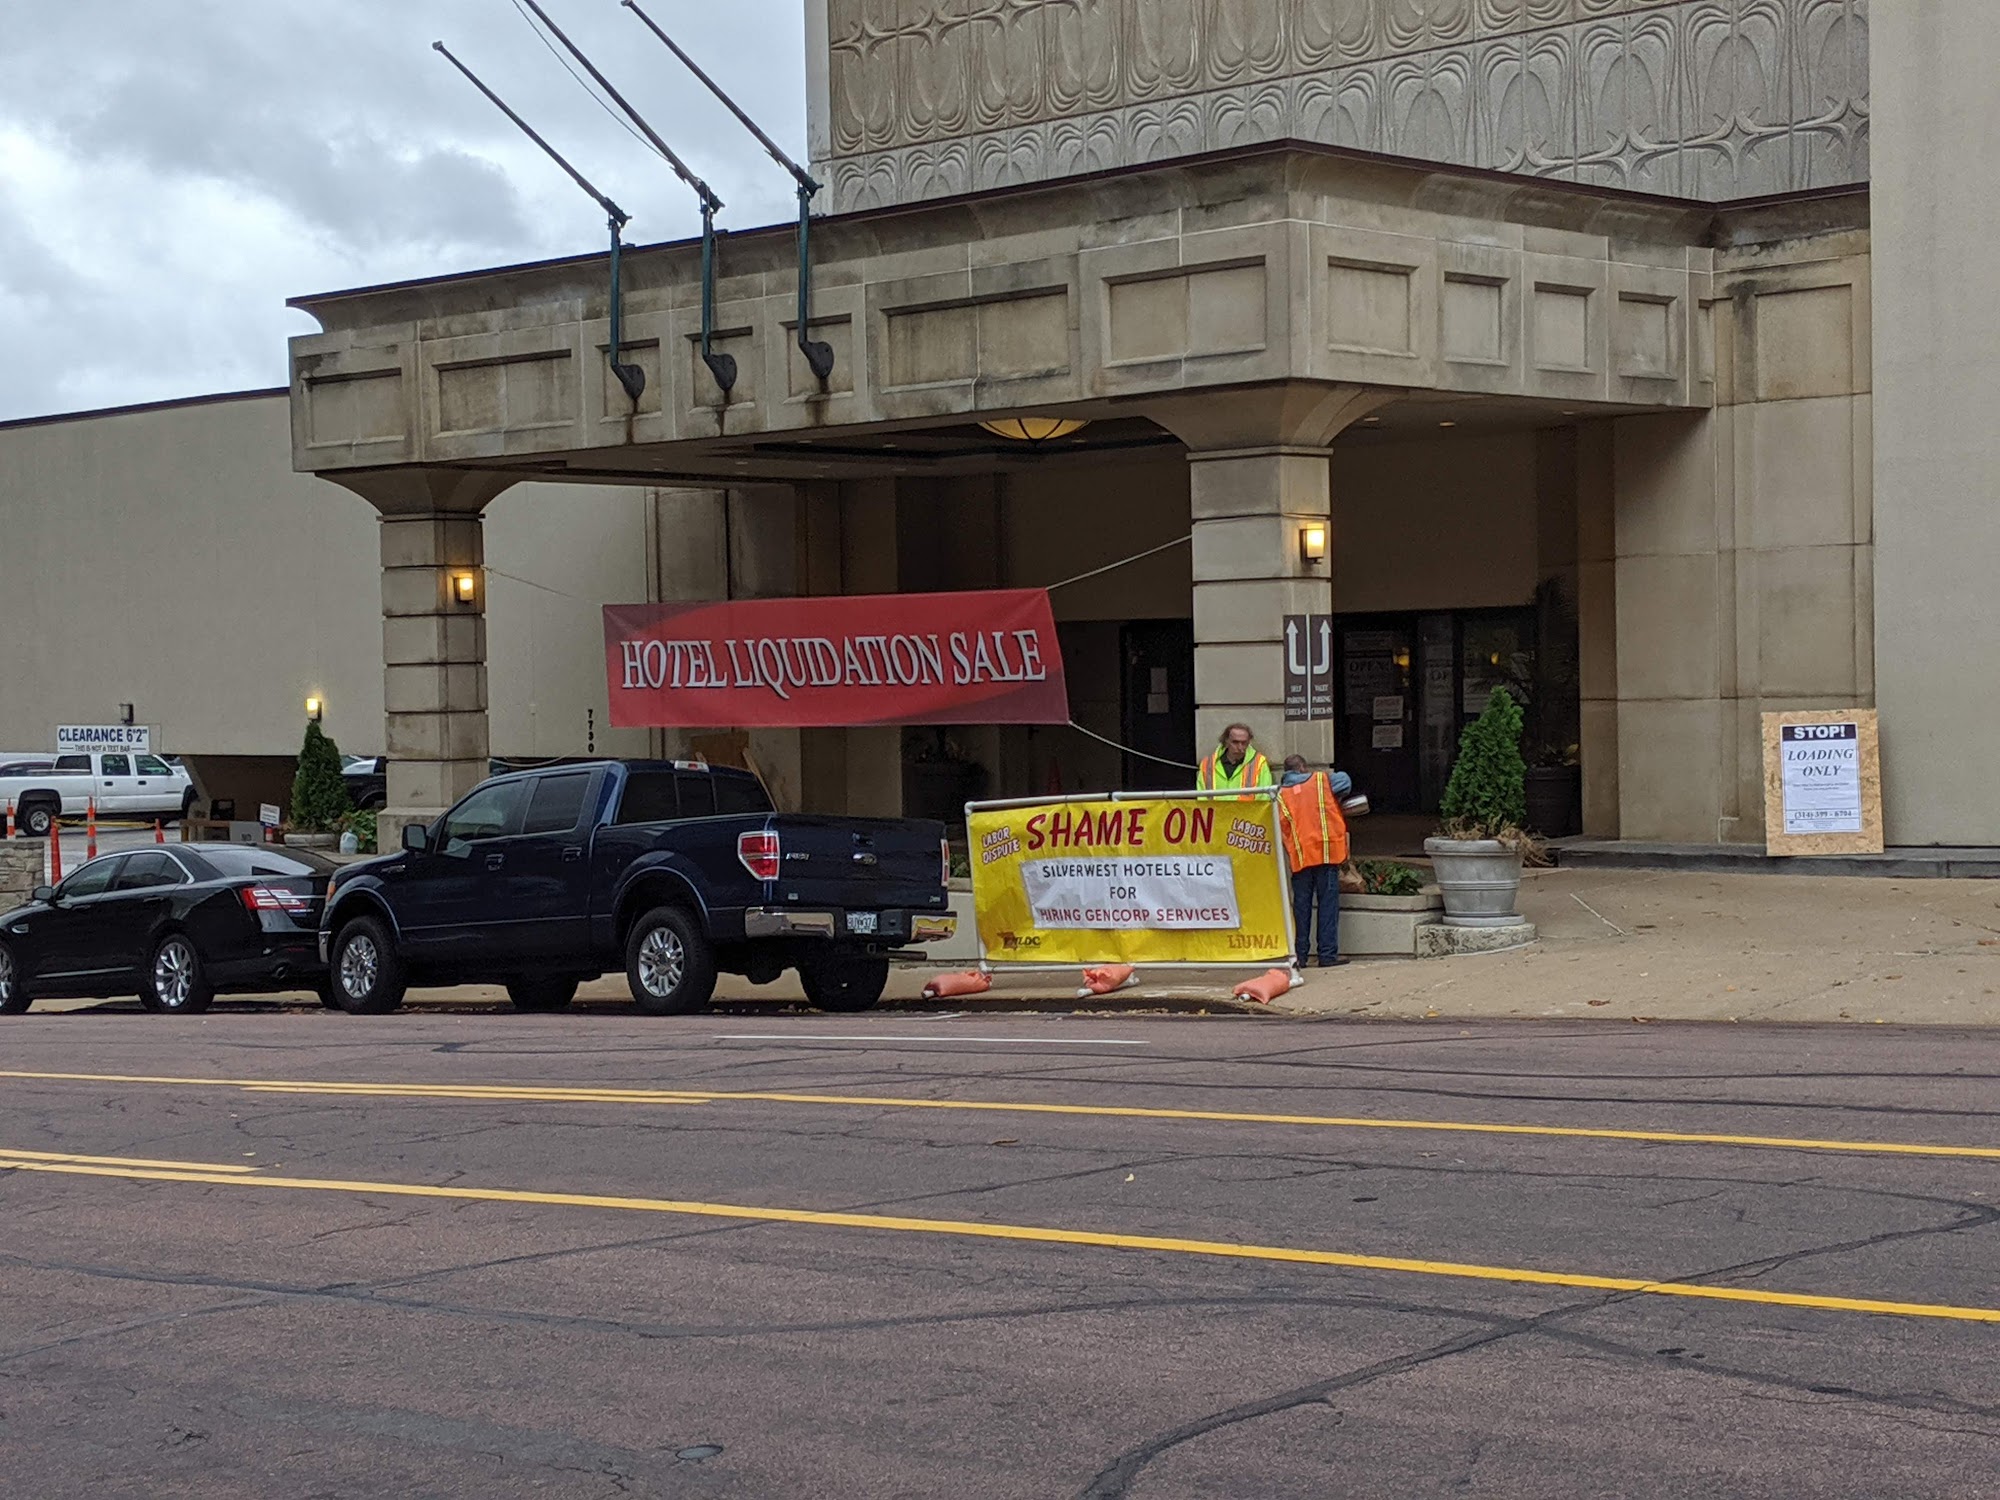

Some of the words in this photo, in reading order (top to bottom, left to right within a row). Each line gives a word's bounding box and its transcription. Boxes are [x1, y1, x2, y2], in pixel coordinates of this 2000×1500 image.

[620, 638, 728, 690] HOTEL
[726, 634, 944, 699] LIQUIDATION
[950, 628, 1046, 685] SALE
[58, 728, 123, 742] CLEARANCE
[587, 708, 595, 753] 7730
[1794, 725, 1846, 739] STOP!
[1788, 748, 1854, 761] LOADING
[1802, 765, 1842, 777] ONLY
[981, 826, 1011, 848] LABOR
[1026, 808, 1147, 851] SHAME
[1163, 806, 1214, 844] ON
[1232, 817, 1267, 839] LABOR
[981, 838, 1021, 865] DISPUTE
[1226, 831, 1272, 855] DISPUTE
[1042, 864, 1118, 879] SILVERWEST
[1123, 863, 1182, 877] HOTELS
[1186, 862, 1214, 876] LLC
[1109, 886, 1137, 900] FOR
[1040, 908, 1081, 922] HIRING
[1084, 907, 1150, 922] GENCORP
[1156, 907, 1231, 922] SERVICES
